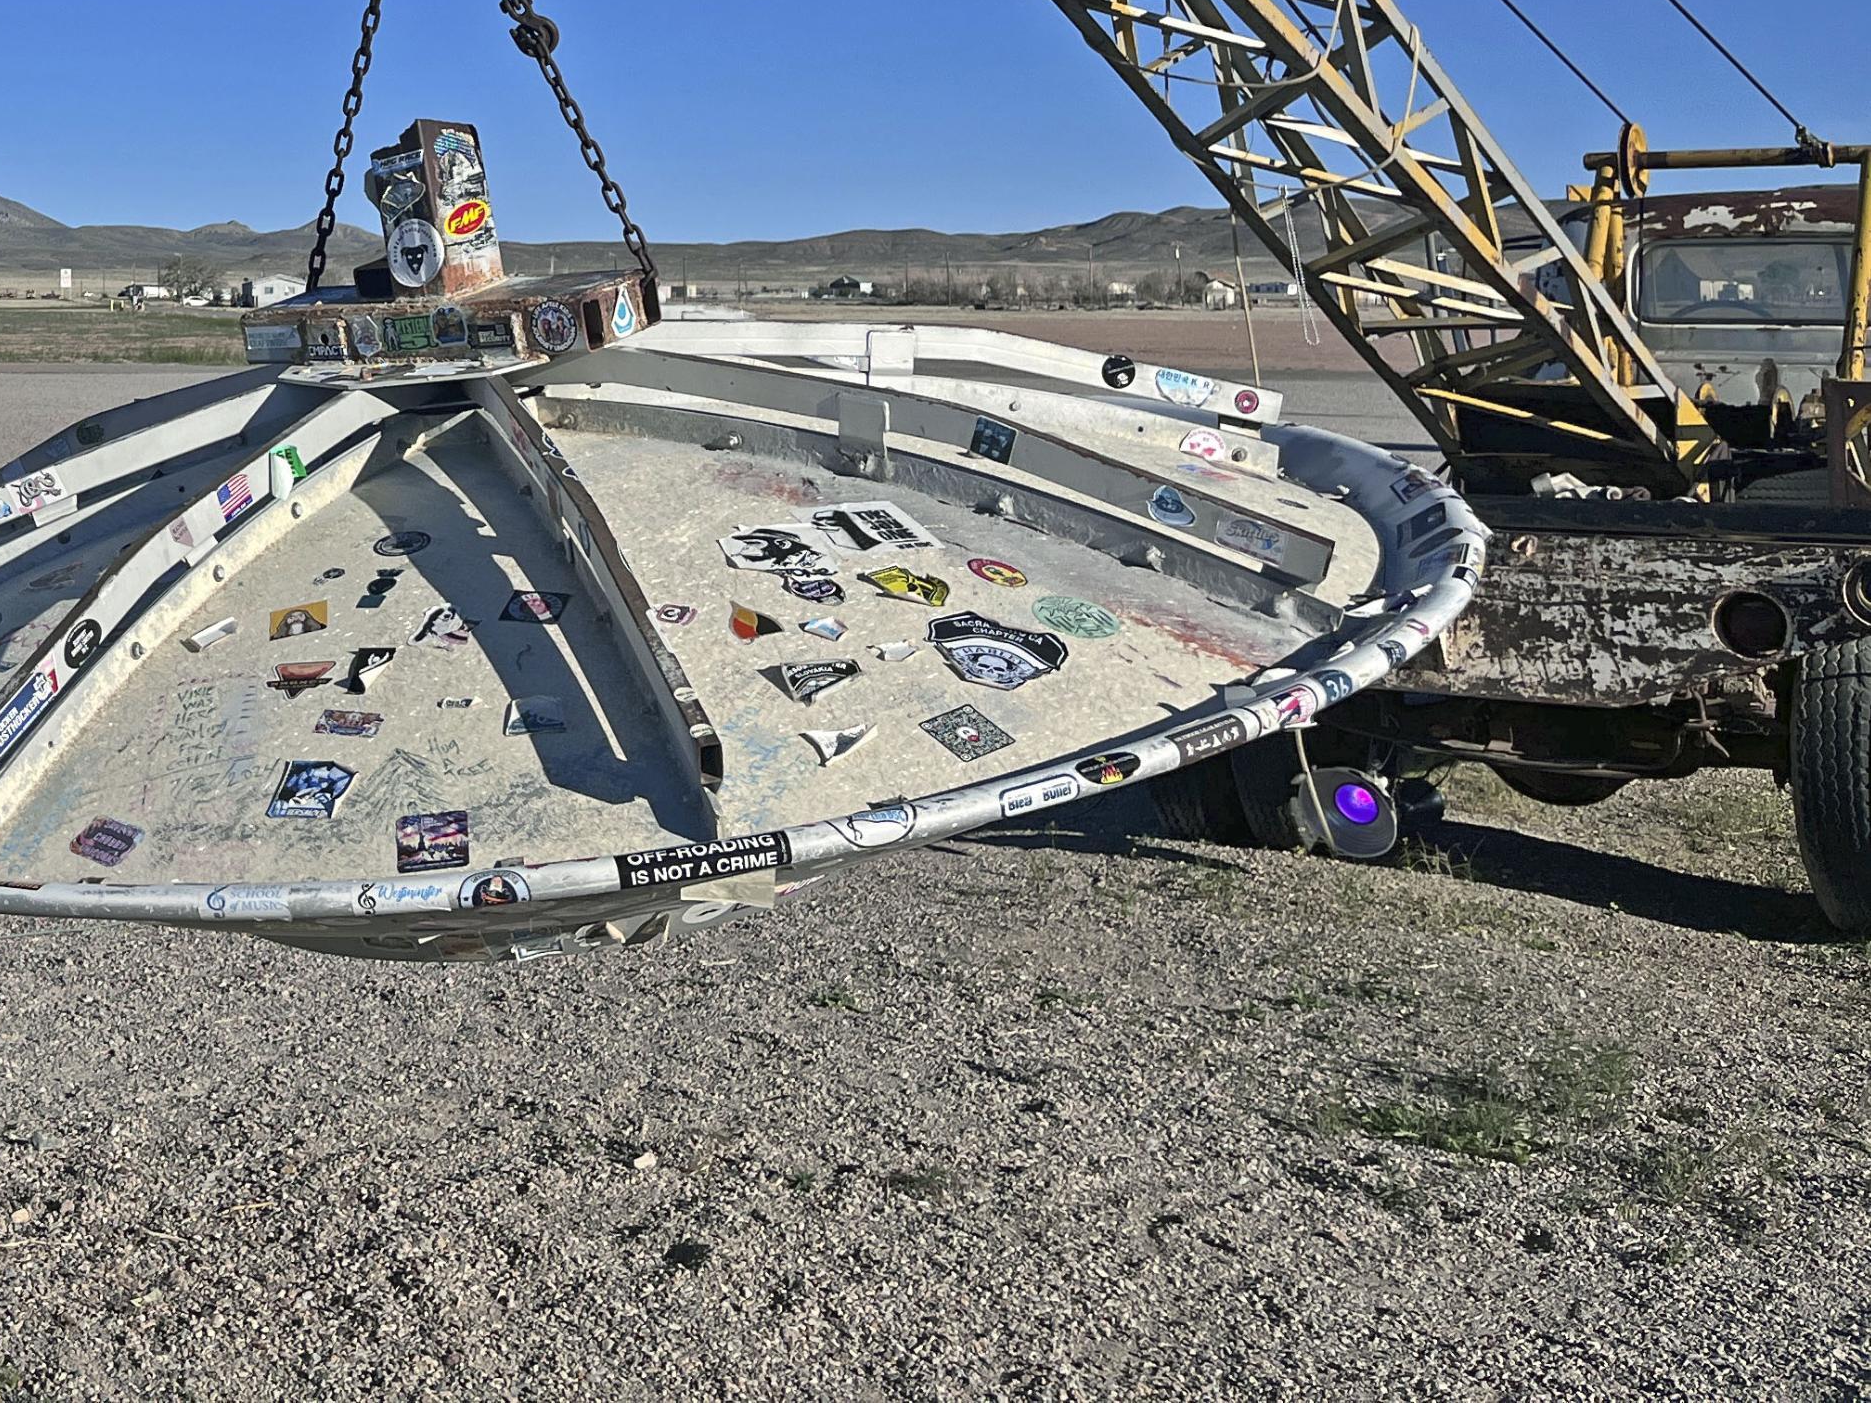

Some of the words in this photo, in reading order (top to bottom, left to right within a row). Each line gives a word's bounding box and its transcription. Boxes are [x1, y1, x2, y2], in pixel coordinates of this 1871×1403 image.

[450, 205, 484, 233] FMF
[972, 627, 1024, 643] CHAPTER
[627, 834, 775, 866] OFF-ROADING
[631, 870, 649, 885] IS
[654, 863, 694, 882] NOT
[699, 860, 712, 876] A
[717, 851, 778, 872] CRIME
[241, 900, 284, 911] MUSIC
